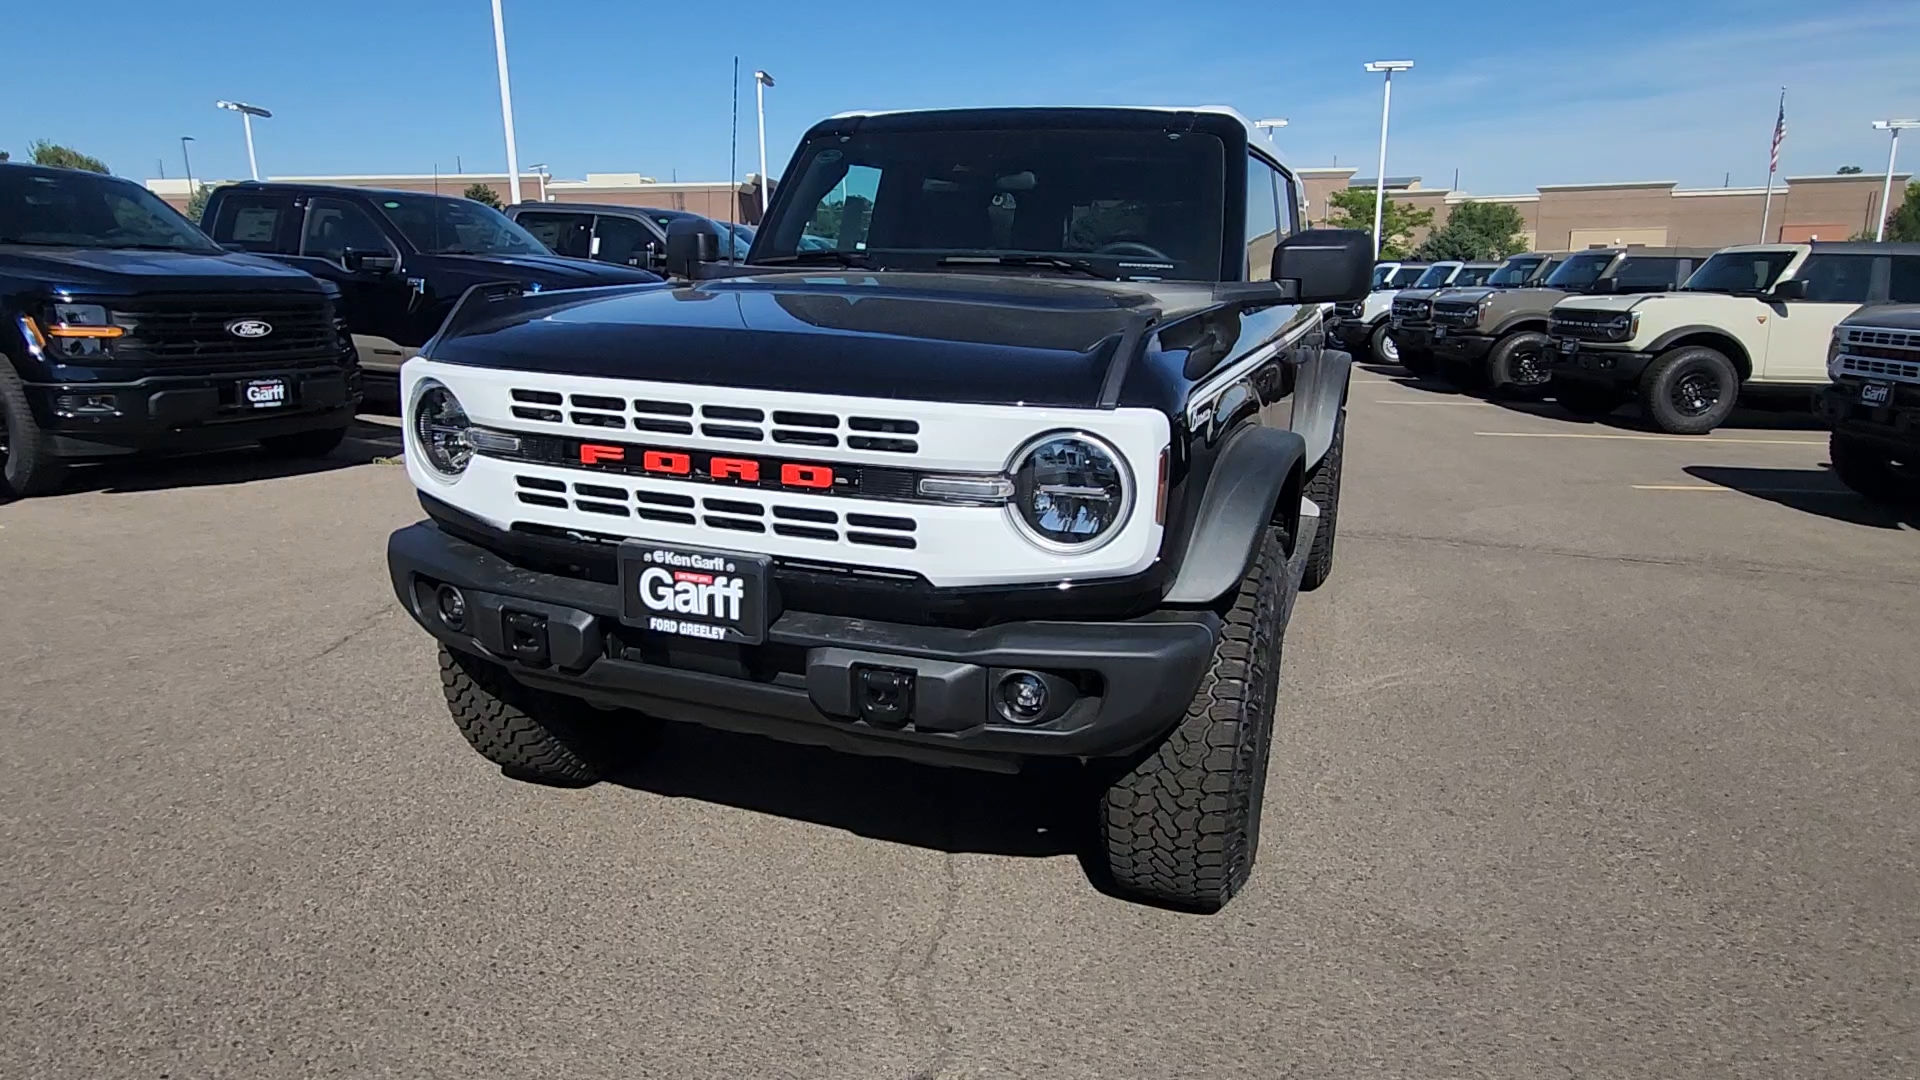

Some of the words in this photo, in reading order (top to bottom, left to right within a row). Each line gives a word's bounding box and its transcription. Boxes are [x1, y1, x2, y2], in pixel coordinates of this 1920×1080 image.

[238, 322, 265, 335] Ford
[247, 385, 284, 402] Garff
[580, 444, 833, 488] FORD
[639, 567, 744, 620] Garff
[650, 617, 677, 633] FORD
[679, 622, 727, 640] GREELEY
